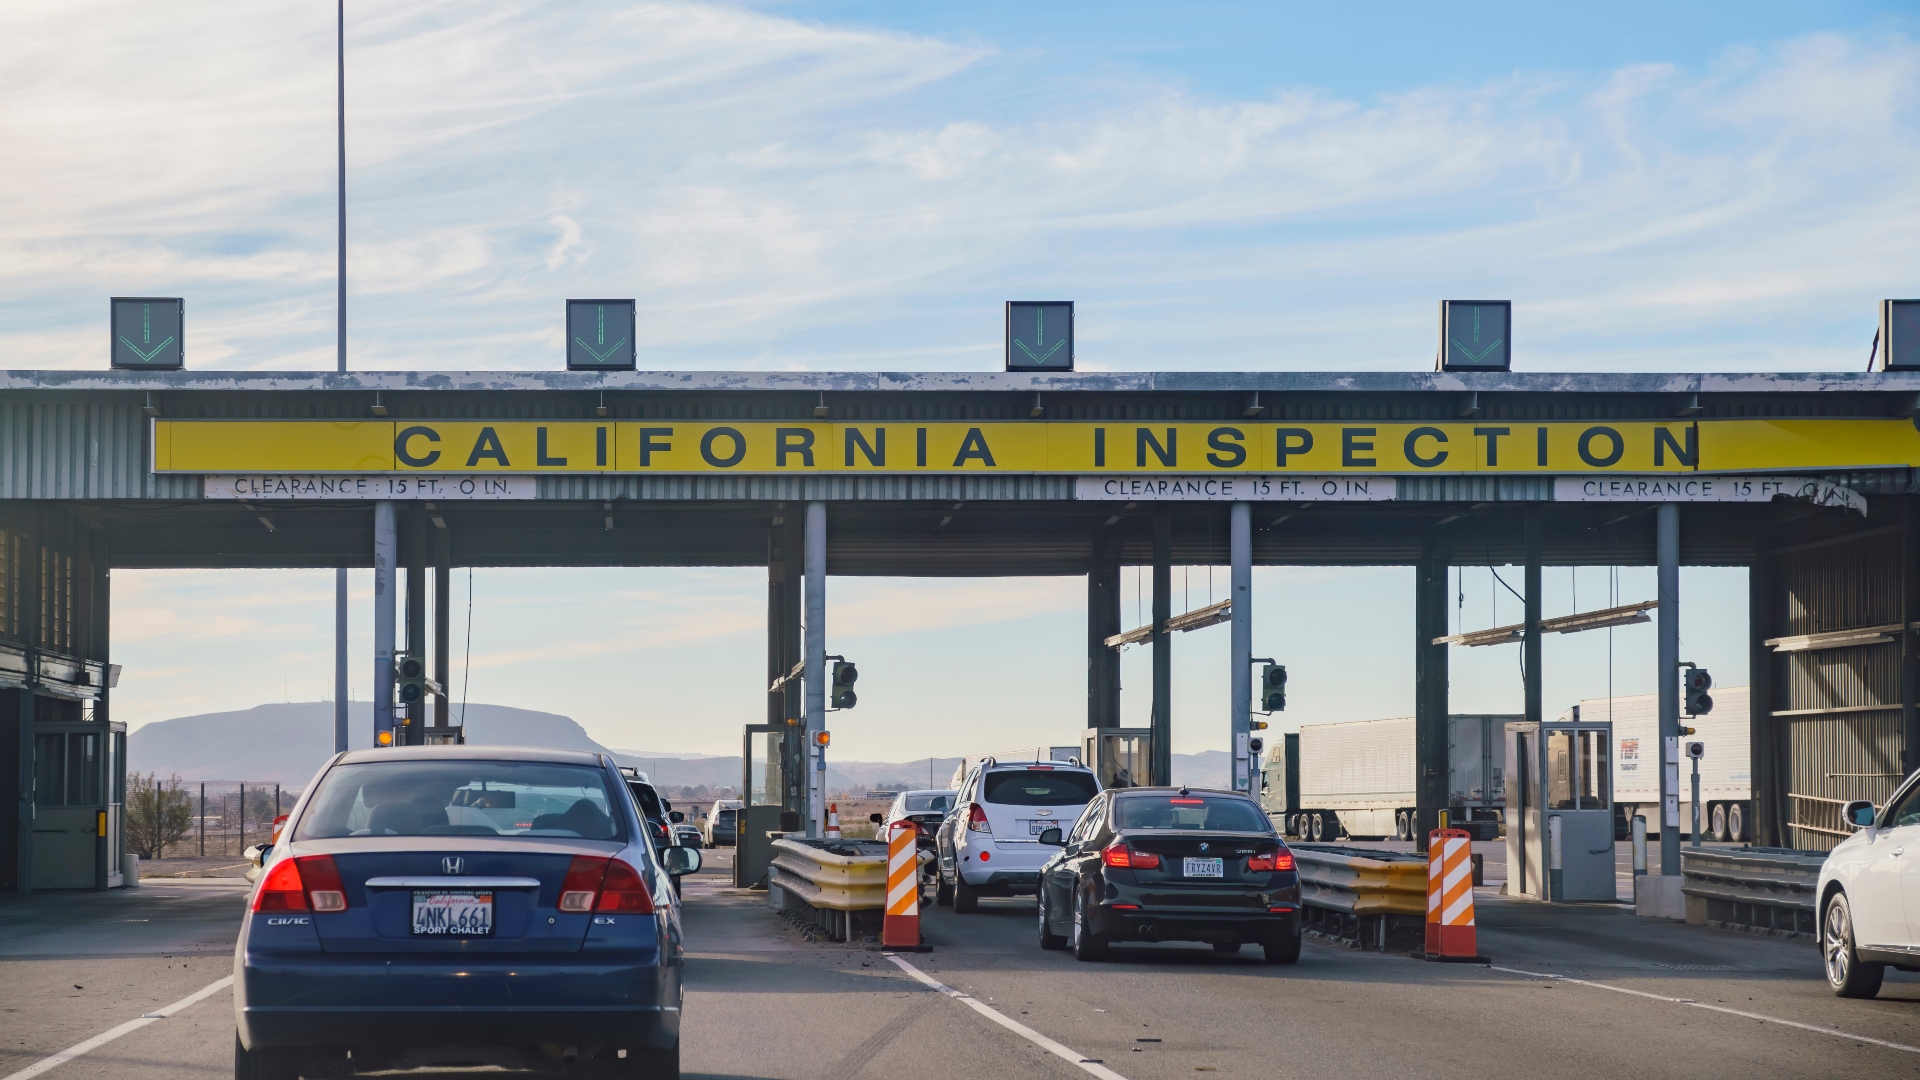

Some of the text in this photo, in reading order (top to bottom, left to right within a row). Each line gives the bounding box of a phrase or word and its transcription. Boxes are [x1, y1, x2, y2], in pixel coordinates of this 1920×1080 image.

[394, 425, 1697, 468] CALIFORNIA INSPECTION
[234, 478, 367, 495] CLEARANCE
[388, 479, 407, 495] 15
[1104, 480, 1233, 496] CLEARANCE
[1253, 480, 1271, 496] 15
[1280, 480, 1305, 496] FT.
[1583, 481, 1713, 497] CLEARANCE
[1733, 481, 1752, 497] 15
[429, 895, 475, 907] California
[267, 917, 310, 926] CIVIC
[416, 906, 489, 927] 4NKL661
[594, 917, 616, 925] EX
